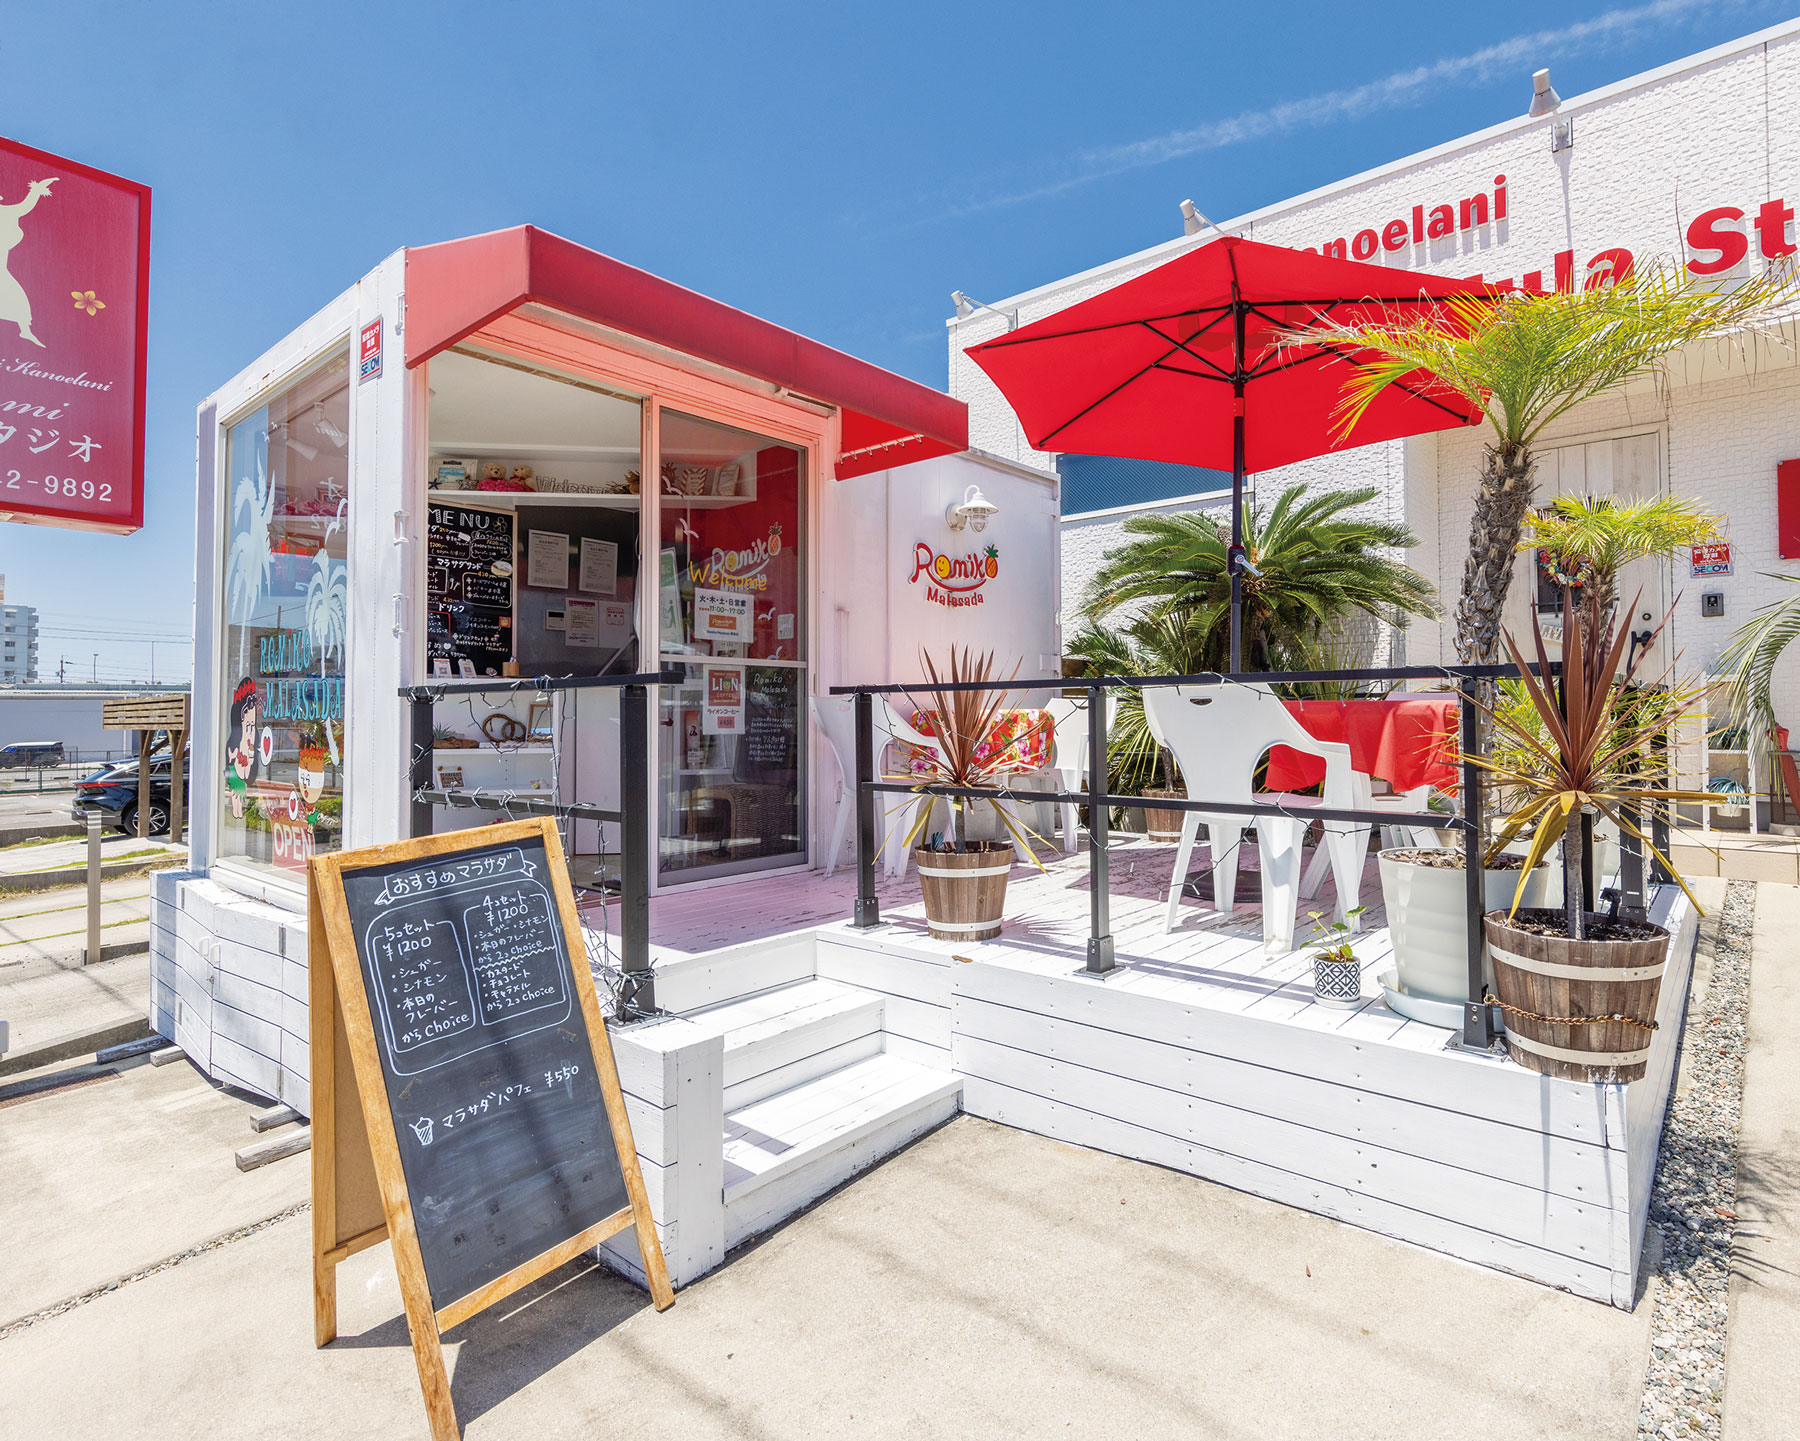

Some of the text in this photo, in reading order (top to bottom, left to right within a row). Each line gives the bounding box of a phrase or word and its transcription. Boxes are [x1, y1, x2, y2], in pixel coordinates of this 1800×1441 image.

[1289, 174, 1507, 261] noelani
[6, 358, 113, 391] Kanoelani
[0, 469, 112, 502] 2-9892
[428, 508, 489, 529] MENU
[437, 558, 483, 570] マラサダサンド
[690, 561, 767, 591] Welcome
[911, 543, 999, 592] Romiko
[1694, 564, 1729, 574] SECOM
[439, 604, 464, 612] ドリンク
[927, 586, 984, 607] Malasada
[262, 679, 341, 722] MALASADA
[273, 822, 312, 862] OPEN
[484, 904, 529, 927] ¥1200
[382, 936, 432, 962] ¥1200
[402, 993, 435, 1010] 本日の
[405, 999, 458, 1024] フレーバー
[442, 1065, 579, 1128] マラサダパフェ ¥550
